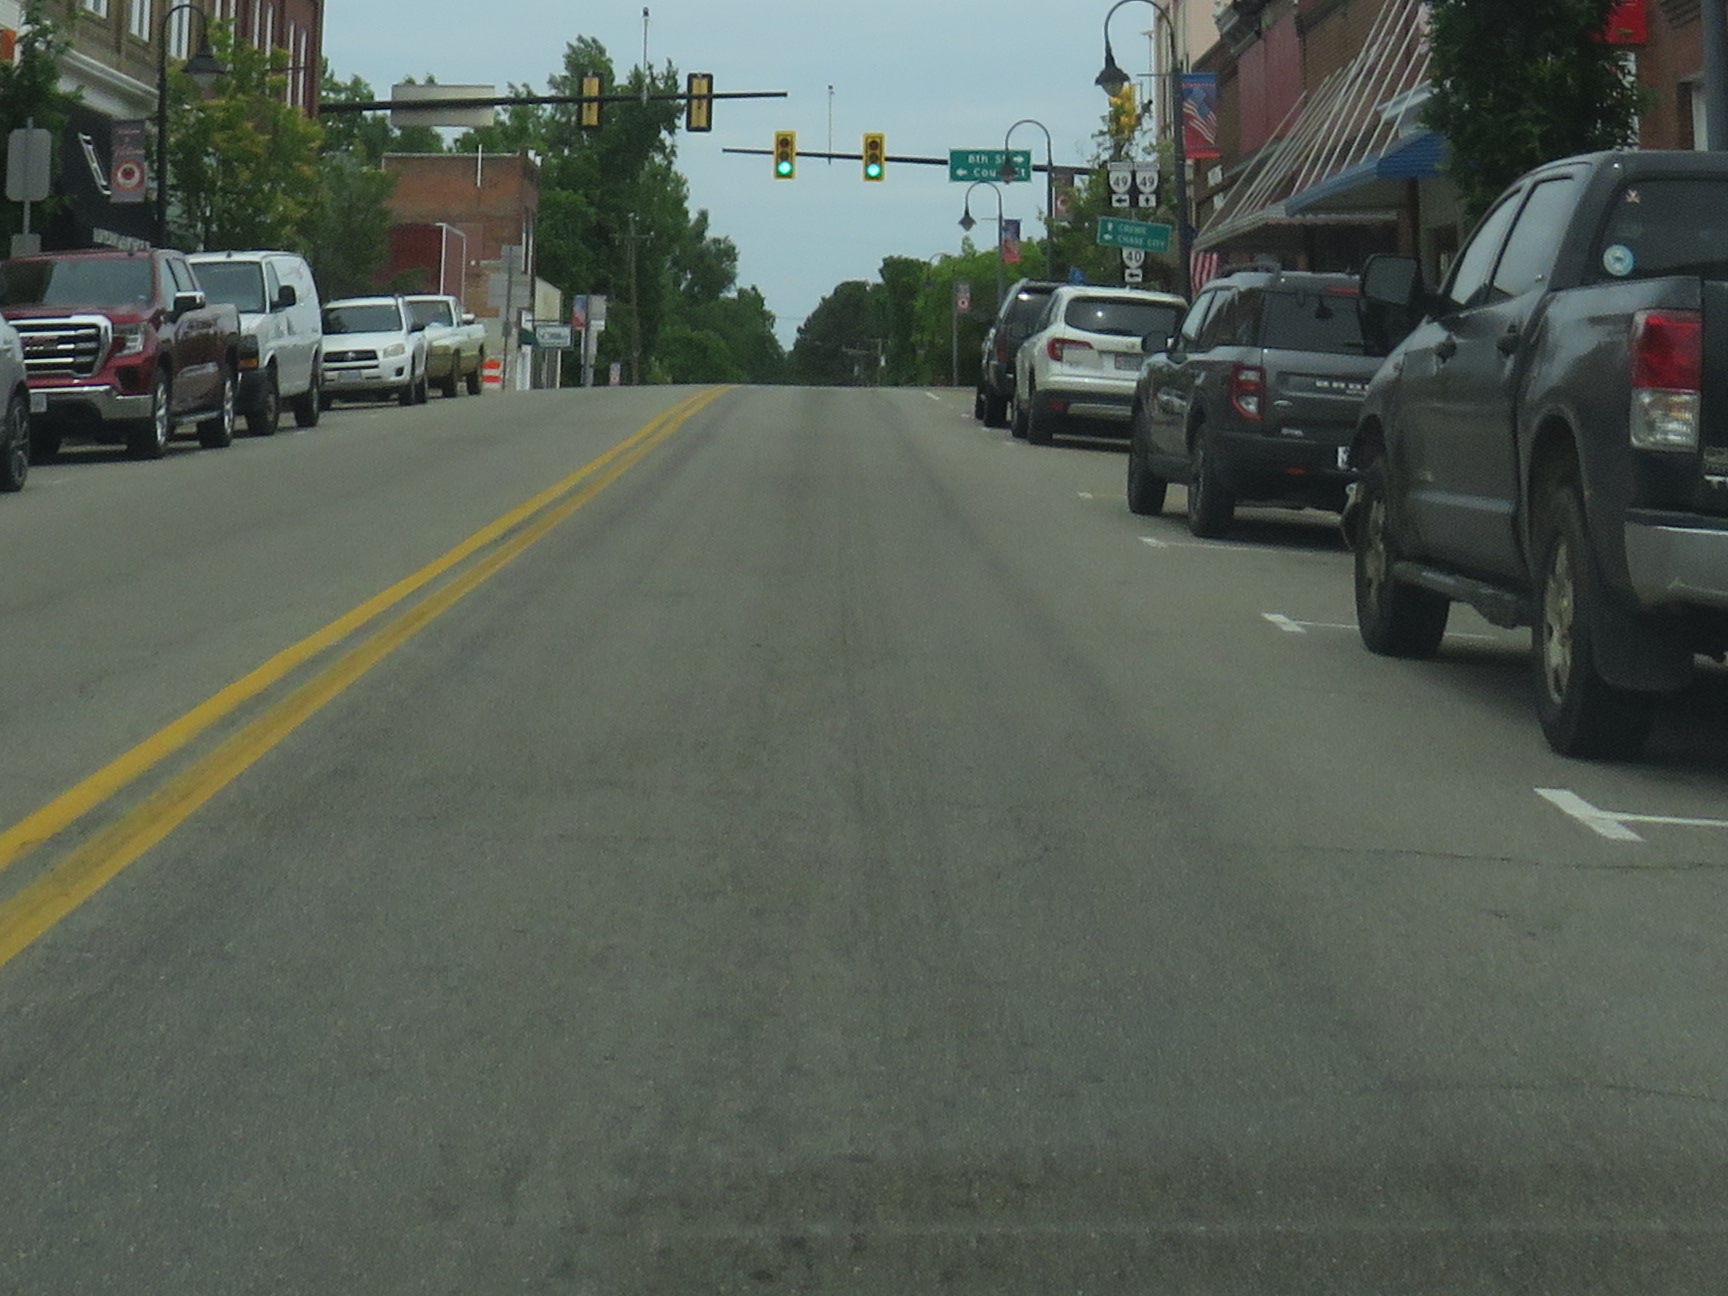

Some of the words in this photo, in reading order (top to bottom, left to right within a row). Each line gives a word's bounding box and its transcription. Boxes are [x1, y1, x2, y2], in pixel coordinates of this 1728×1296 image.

[1113, 176, 1129, 188] 49
[1139, 176, 1155, 188] 49
[1127, 251, 1141, 262] 40
